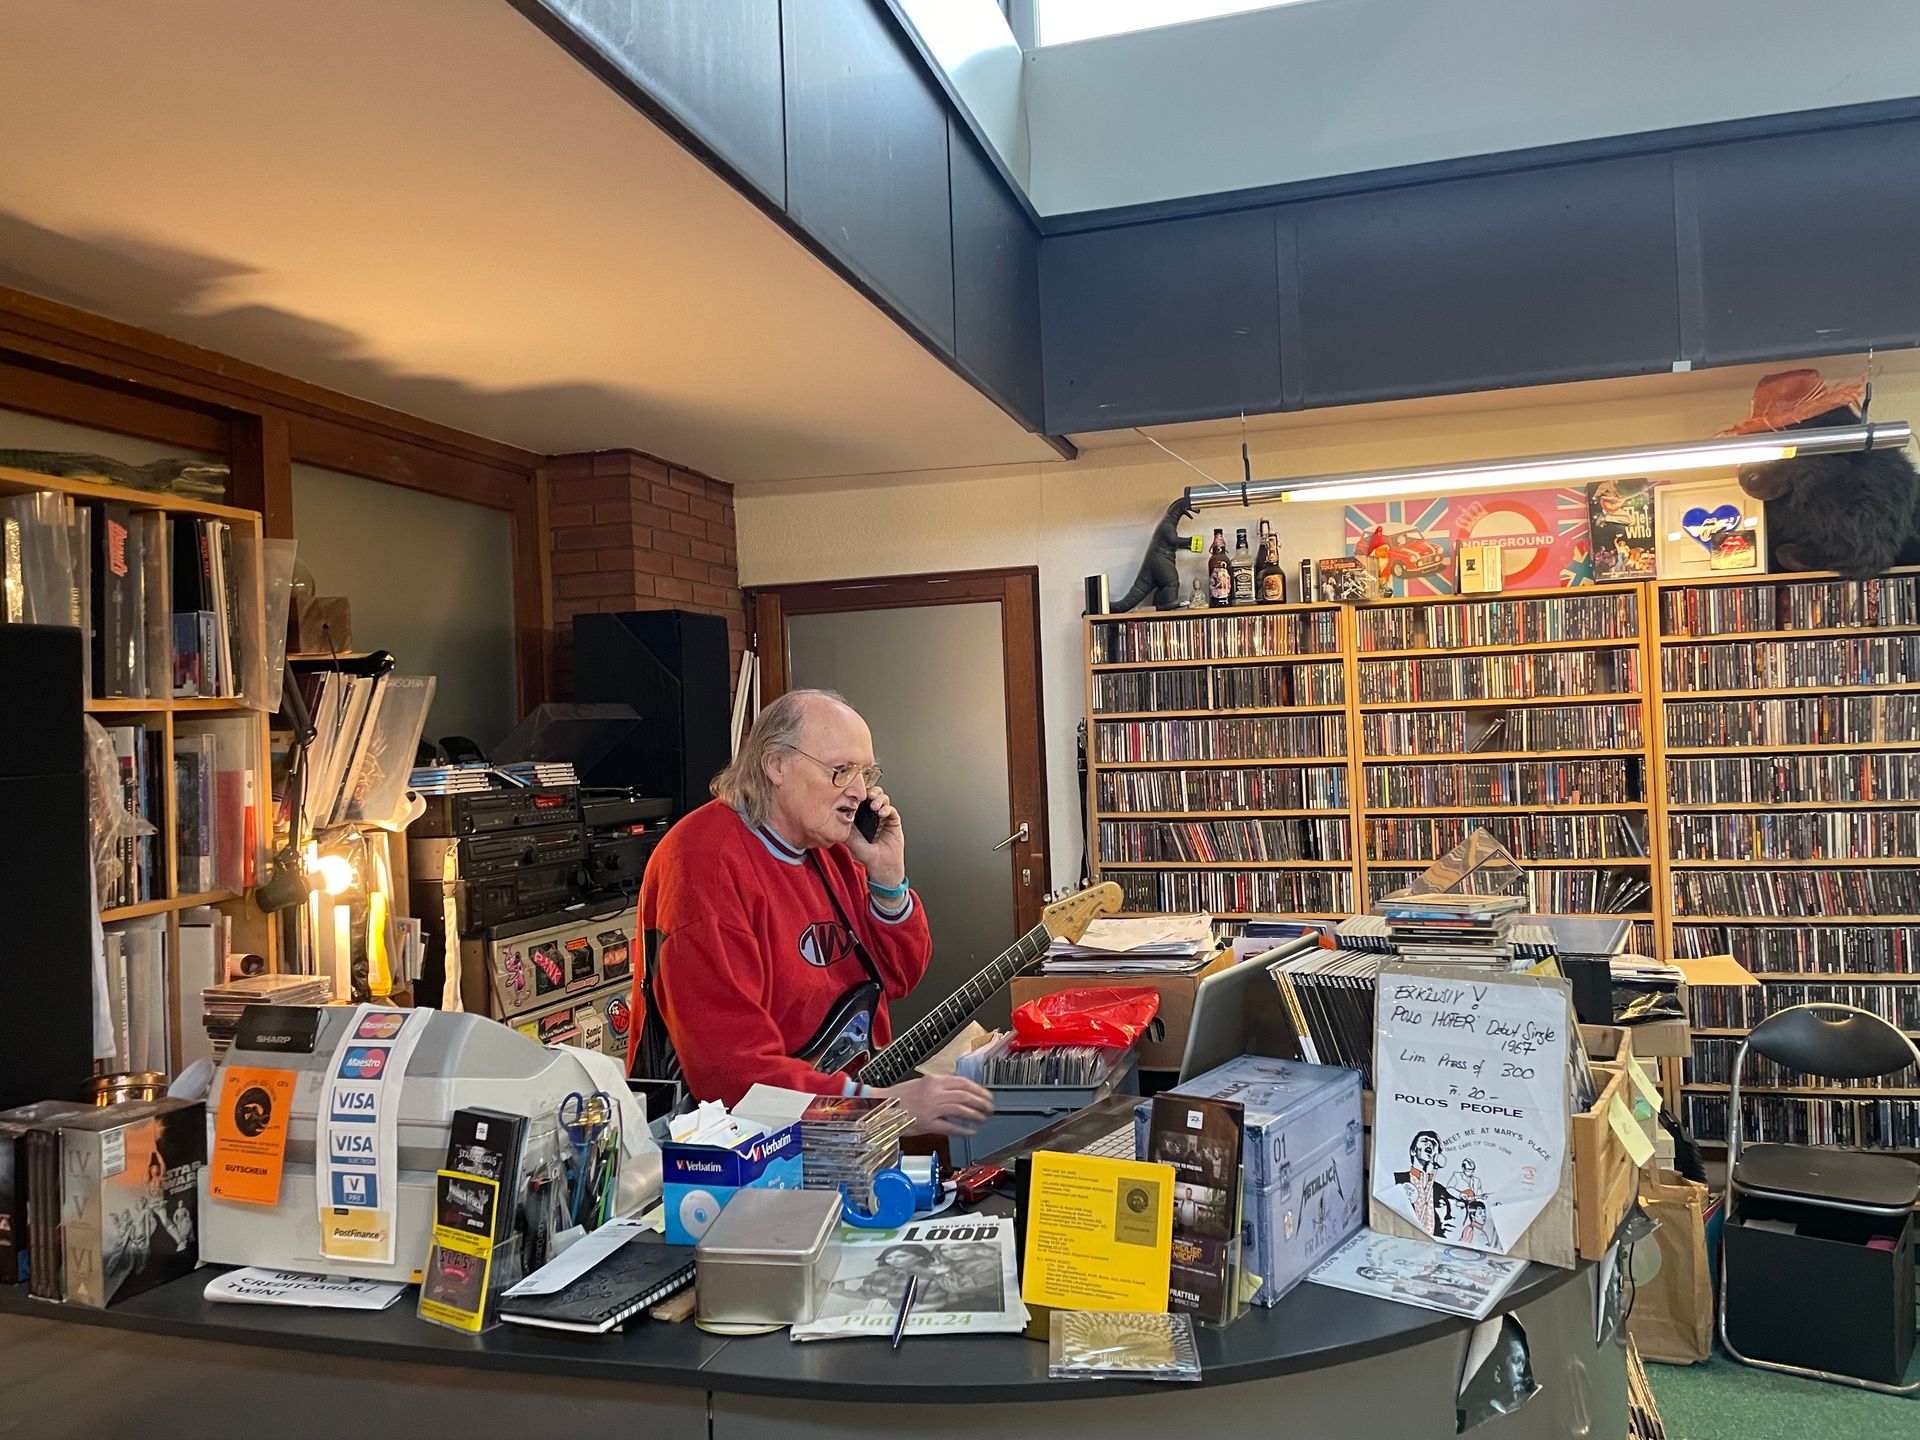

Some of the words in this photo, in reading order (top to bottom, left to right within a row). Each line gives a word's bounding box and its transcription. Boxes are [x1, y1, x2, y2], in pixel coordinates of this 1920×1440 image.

[1391, 1005, 1422, 1024] POLO
[1522, 1020, 1556, 1046] Single
[256, 1035, 291, 1043] SHARP
[1502, 1039, 1537, 1055] 1967
[346, 1057, 382, 1067] Maestro
[1501, 1063, 1535, 1079] 300
[338, 1092, 375, 1110] VISA
[1394, 1094, 1448, 1108] POLO'S
[1460, 1102, 1524, 1118] PEOPLE
[336, 1135, 373, 1153] VISA
[761, 1133, 792, 1158] Verbatim
[1272, 1133, 1287, 1164] 01
[1442, 1133, 1461, 1147] MEET
[1464, 1128, 1476, 1137] ME
[1494, 1127, 1524, 1141] MARY'S
[1527, 1139, 1552, 1162] PLACE
[166, 1160, 203, 1179] STAR
[225, 1164, 268, 1176] GUTSCHEIN
[686, 1160, 723, 1173] Verbatim
[161, 1171, 197, 1190] WAR
[348, 1177, 360, 1191] V
[334, 1227, 380, 1240] PostFinance
[227, 1281, 289, 1296] TWINT
[1169, 1288, 1200, 1302] PRATTELN
